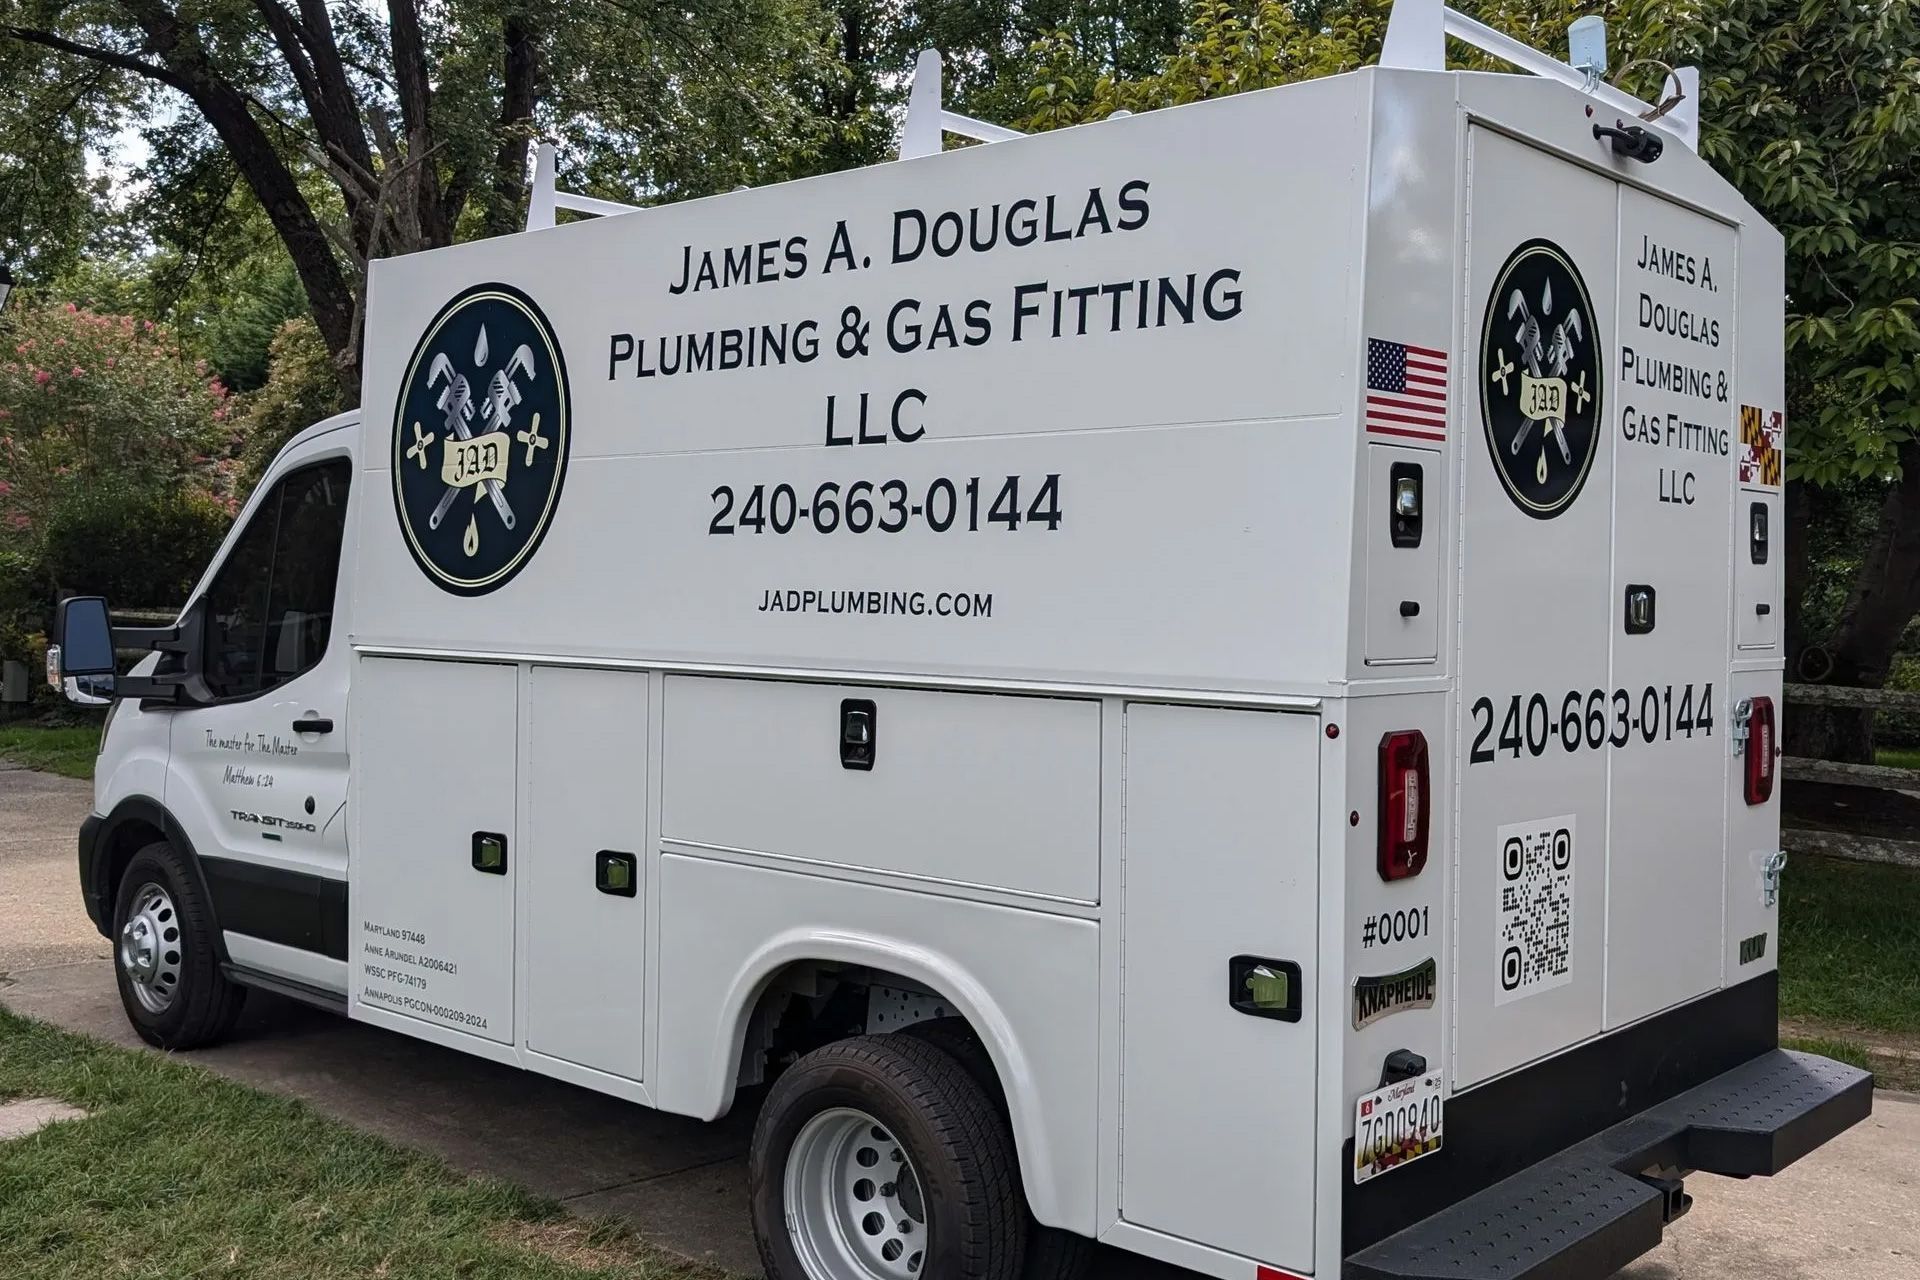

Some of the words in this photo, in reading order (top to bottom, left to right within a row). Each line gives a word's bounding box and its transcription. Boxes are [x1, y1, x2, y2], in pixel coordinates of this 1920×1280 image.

[668, 236, 808, 295] JAMES
[822, 220, 872, 275] A.
[891, 180, 1151, 264] DOUGLAS
[1637, 235, 1696, 284] JAMES
[1700, 257, 1718, 293] A.
[607, 319, 819, 381] PLUMBING
[836, 305, 870, 358] &
[886, 298, 992, 353] GAS
[1011, 268, 1244, 342] FITTING
[1639, 292, 1720, 348] DOUGLAS
[1621, 346, 1711, 401] PLUMBING
[1716, 370, 1728, 403] &
[824, 388, 928, 447] LLC
[1529, 384, 1560, 414] JAD
[1622, 405, 1660, 446] GAS
[1666, 413, 1729, 457] FITTING
[454, 443, 498, 482] JAD
[708, 474, 1062, 536] 240-663-0144
[1659, 468, 1696, 505] LLC
[758, 589, 992, 618] JADPLUMBING.COM
[206, 729, 217, 748] The
[219, 735, 242, 750] master
[244, 732, 254, 752] for
[258, 734, 270, 753] The
[272, 736, 298, 756] Master
[1470, 683, 1713, 767] 240-663-0144
[223, 765, 254, 786] Matthew
[256, 774, 273, 788] 6:24
[231, 810, 286, 827] TRANSIT
[364, 921, 400, 939] MARYLAND
[401, 930, 426, 945] 97448
[1362, 905, 1428, 948] #0001
[364, 943, 383, 957] ANNE
[384, 948, 417, 965] ARUNDEL
[418, 956, 457, 975] A2006421
[1740, 932, 1768, 965] KUV
[364, 963, 386, 979] WSSC
[387, 970, 427, 990] PFG-74179
[1358, 965, 1433, 1022] KNAPHEIDE
[364, 986, 402, 1006] ANNAPOLIS
[404, 997, 488, 1029] PGCON-000209-2024
[1387, 1080, 1416, 1102] Maryland
[1362, 1095, 1440, 1163] 7GD0940
